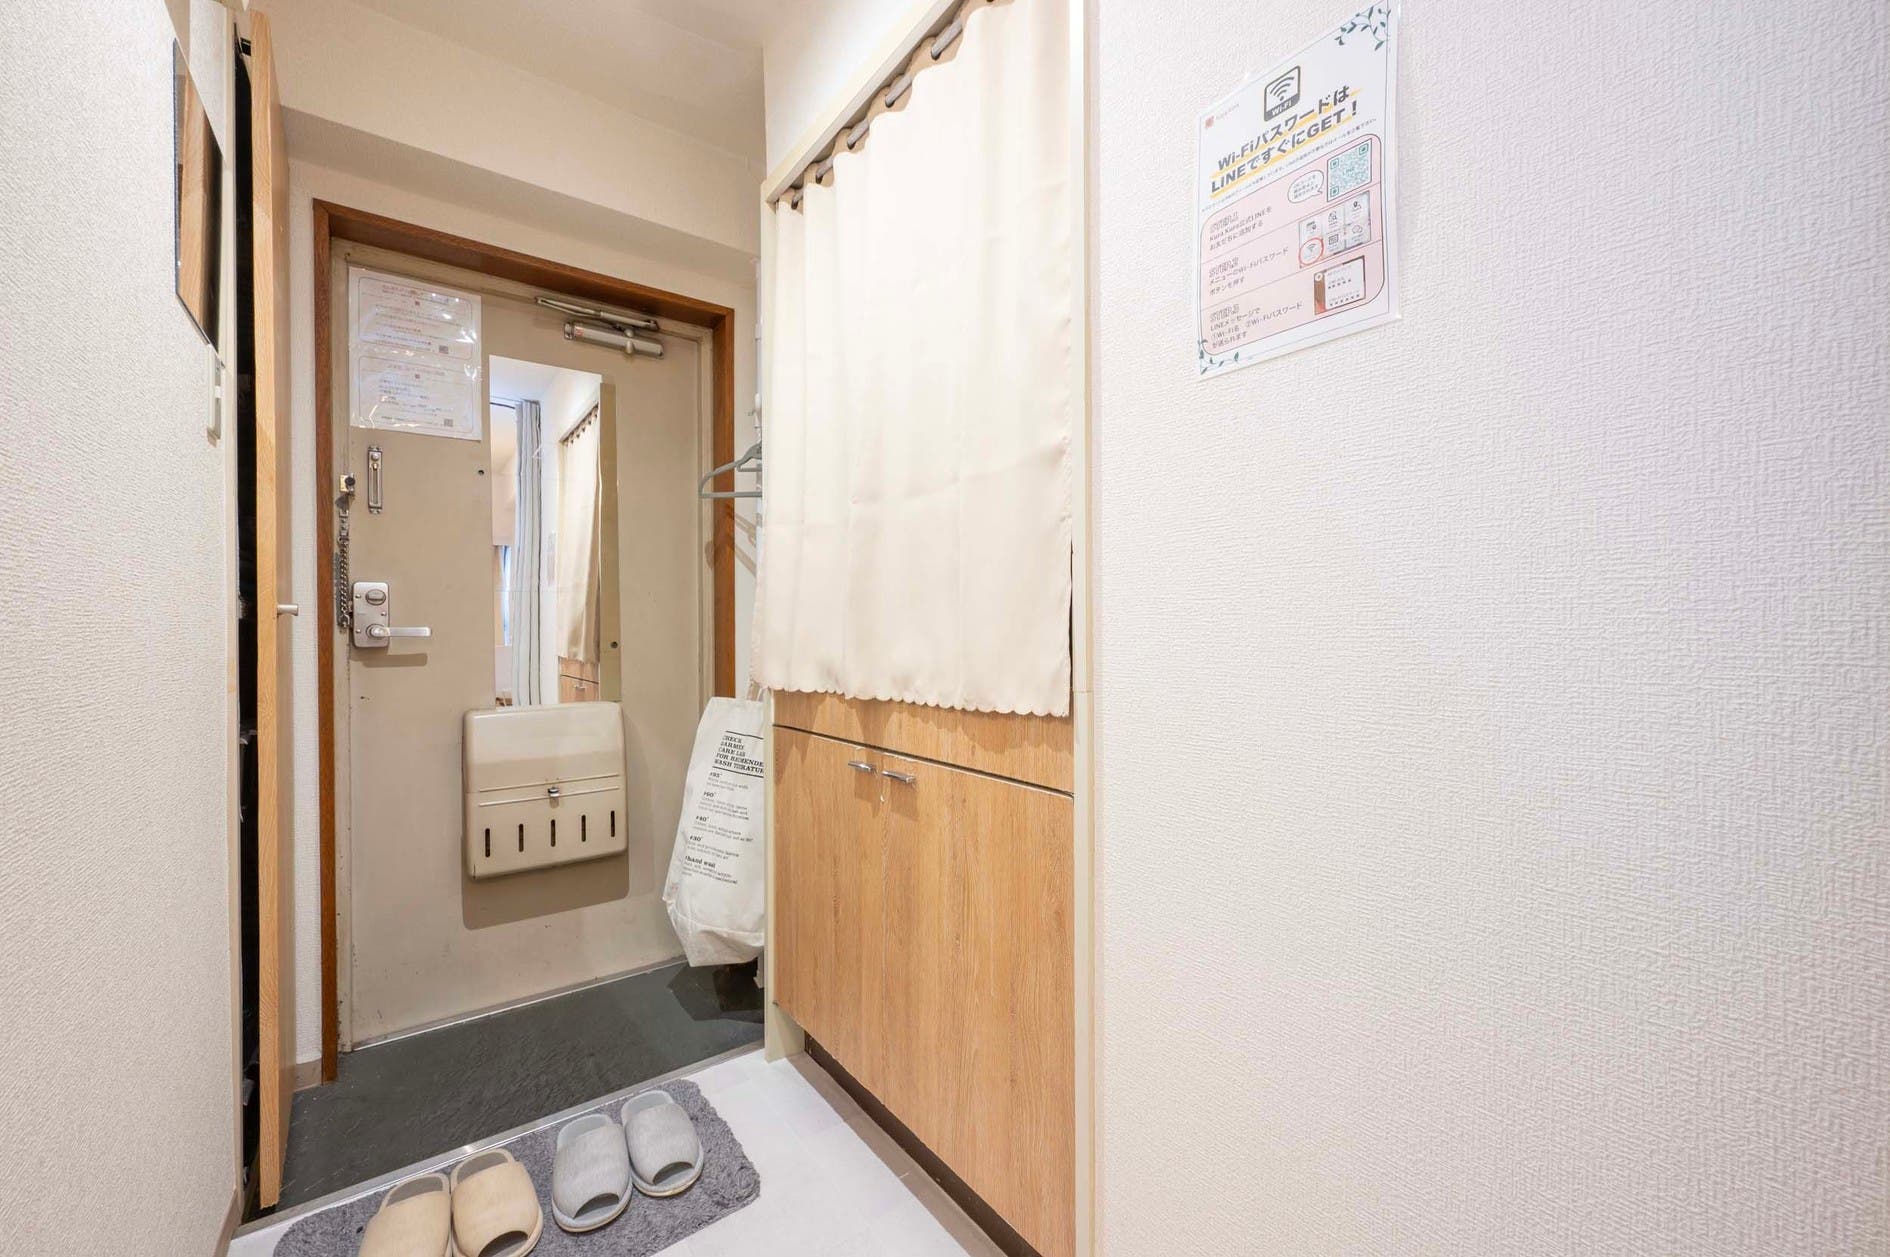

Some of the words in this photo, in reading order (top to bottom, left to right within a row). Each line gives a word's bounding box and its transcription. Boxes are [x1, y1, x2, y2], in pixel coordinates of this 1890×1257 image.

[1217, 85, 1350, 171] Wi-Fiパスワードは
